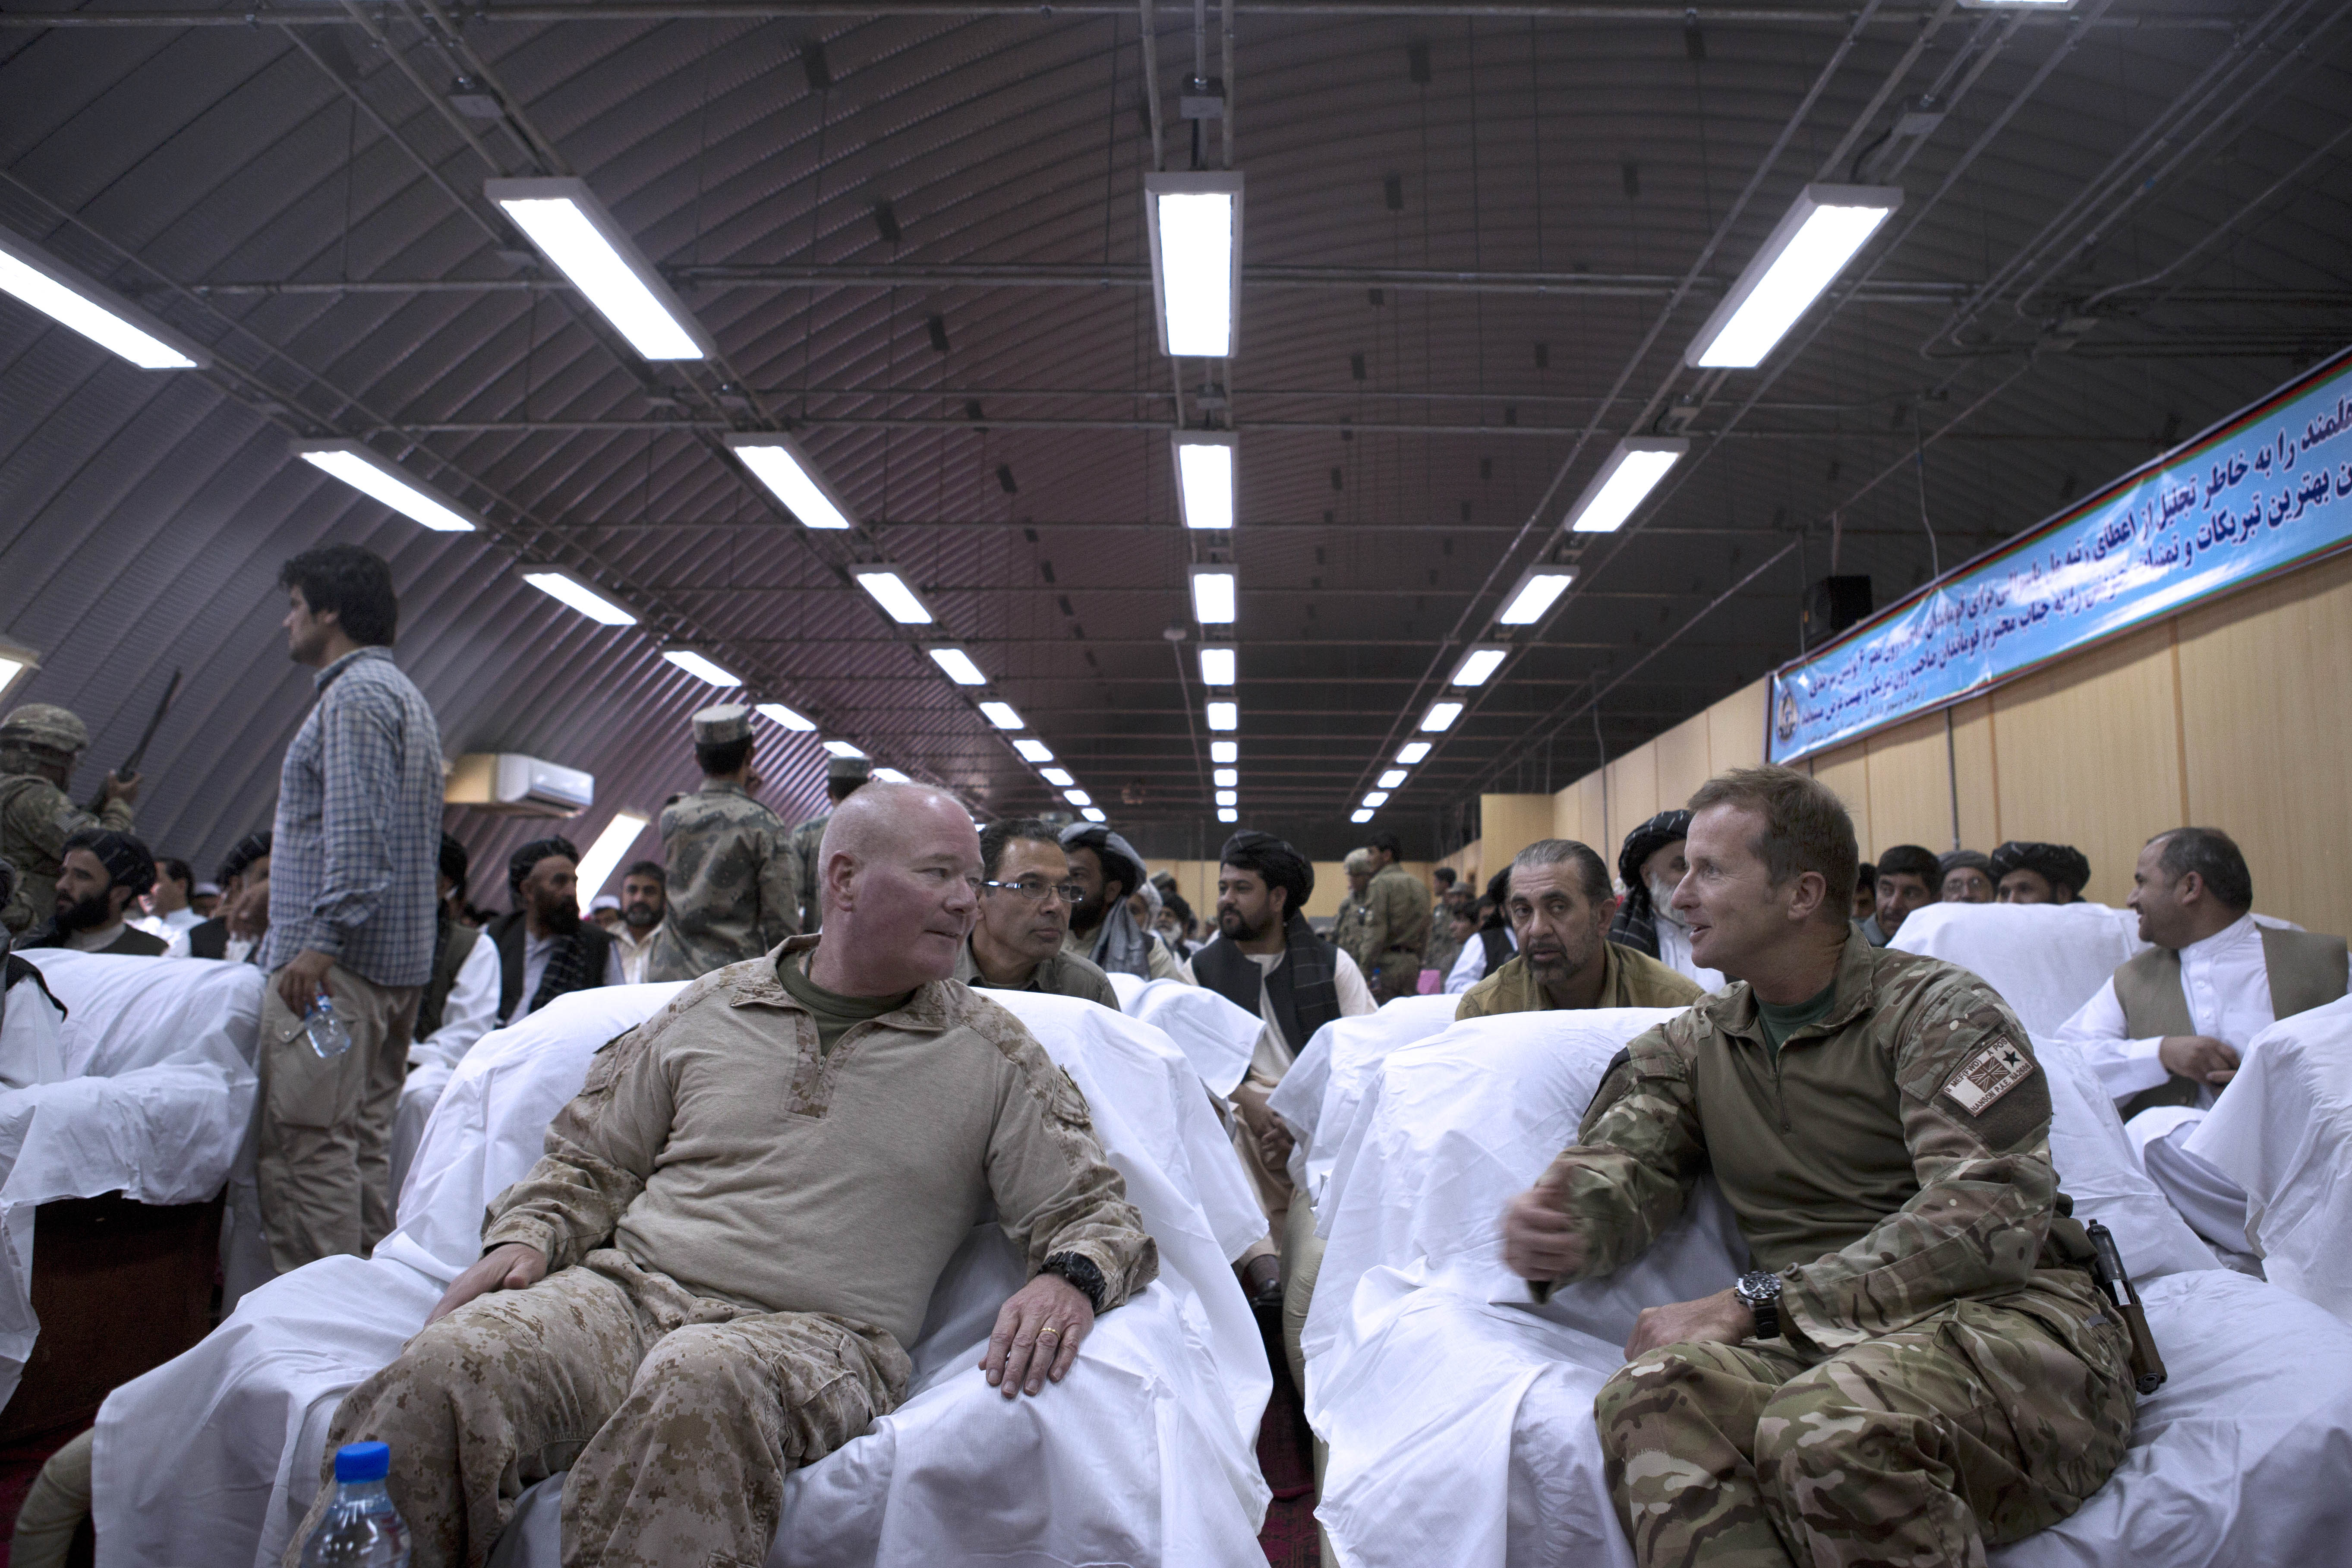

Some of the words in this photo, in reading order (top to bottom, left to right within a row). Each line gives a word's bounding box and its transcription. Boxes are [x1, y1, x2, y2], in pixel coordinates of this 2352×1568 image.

[2254, 447, 2272, 479] به
[2277, 430, 2295, 470] را
[2203, 452, 2249, 510] خاطر
[2267, 470, 2330, 528] بهترین
[2159, 475, 2197, 530] تجلیل
[2197, 496, 2262, 549] تبریکات
[2094, 511, 2137, 562] اعطای
[2184, 541, 2192, 568] و
[2019, 598, 2051, 632] جناب
[1950, 1058, 1983, 1087] MEF(FWD)
[1970, 1089, 1996, 1112] NANSON
